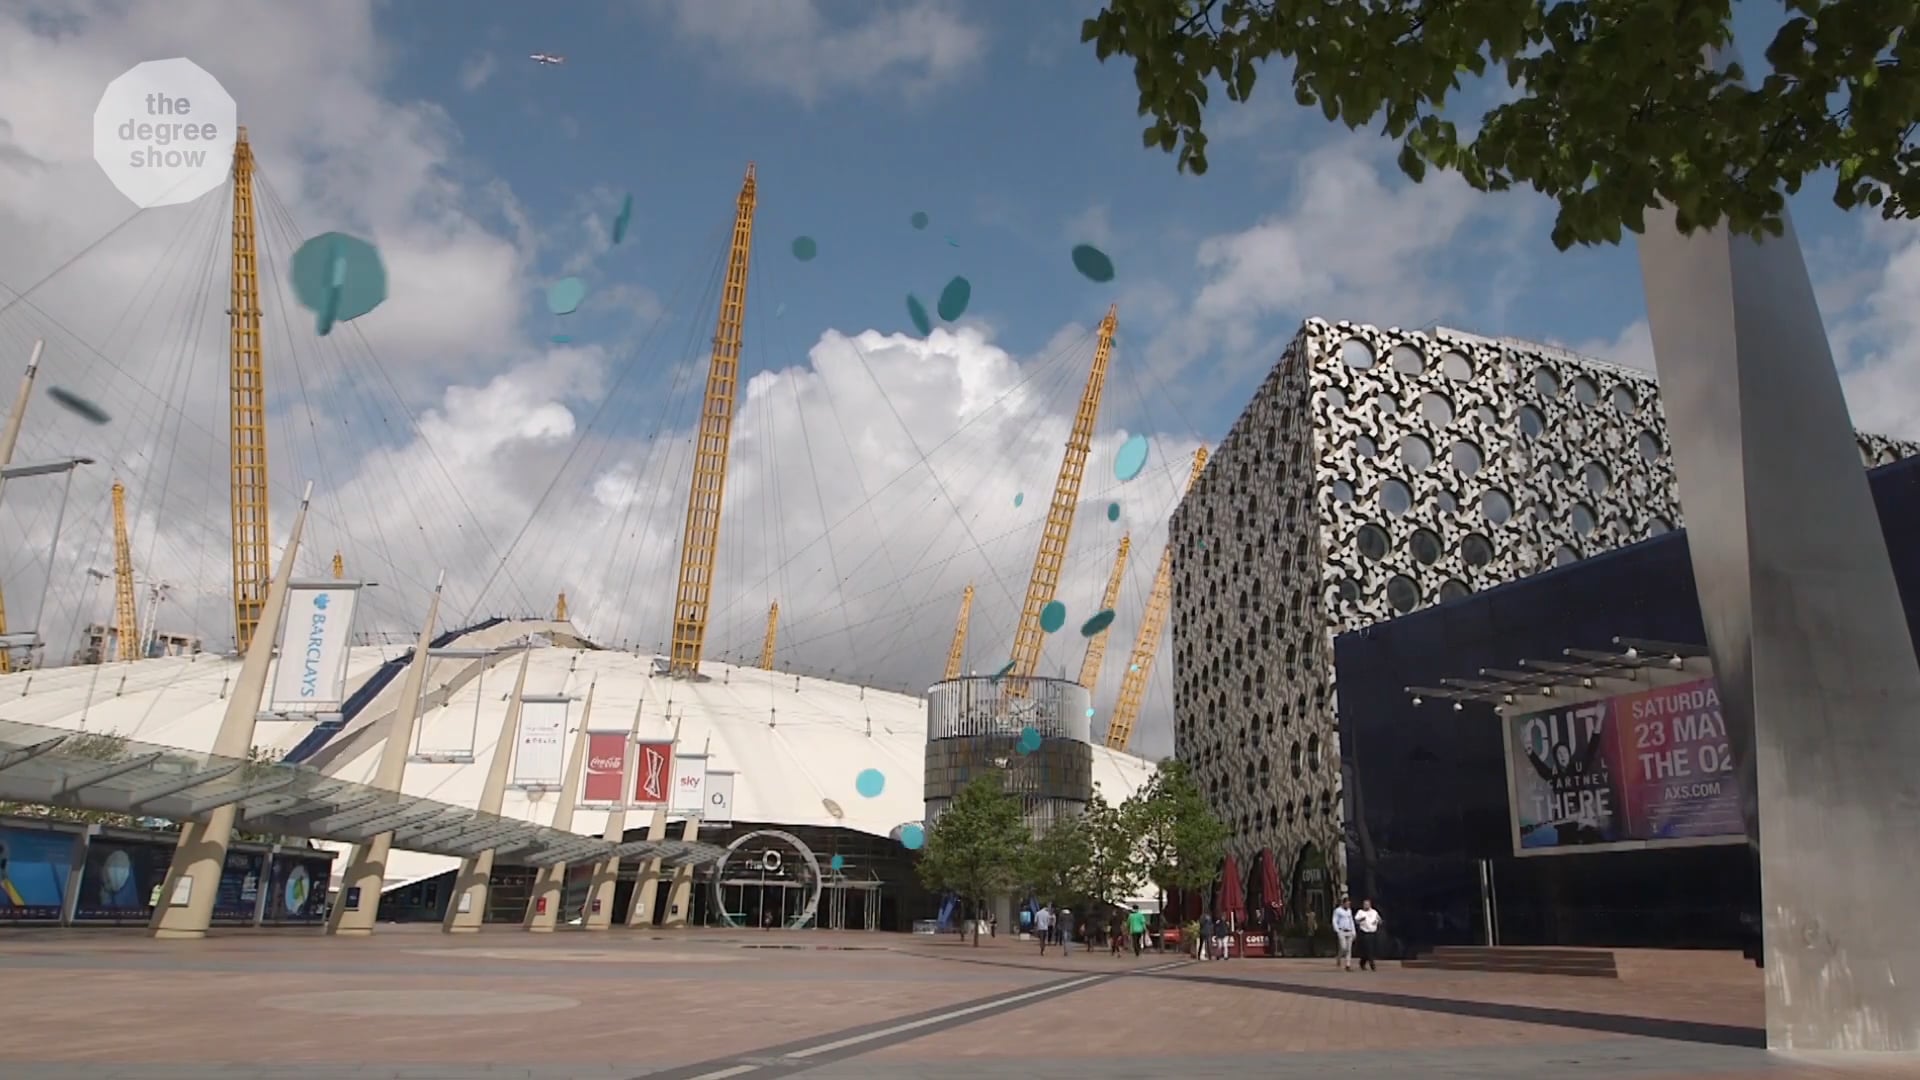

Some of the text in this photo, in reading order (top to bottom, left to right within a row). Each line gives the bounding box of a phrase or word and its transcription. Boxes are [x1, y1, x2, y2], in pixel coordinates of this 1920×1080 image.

[301, 614, 326, 697] BARCLAYS
[1632, 688, 1721, 719] SATURDA
[1634, 717, 1665, 748] 23
[1638, 748, 1691, 781] THE
[680, 776, 700, 788] sky
[1665, 782, 1721, 800] AXS.COM
[1530, 788, 1613, 822] THERE
